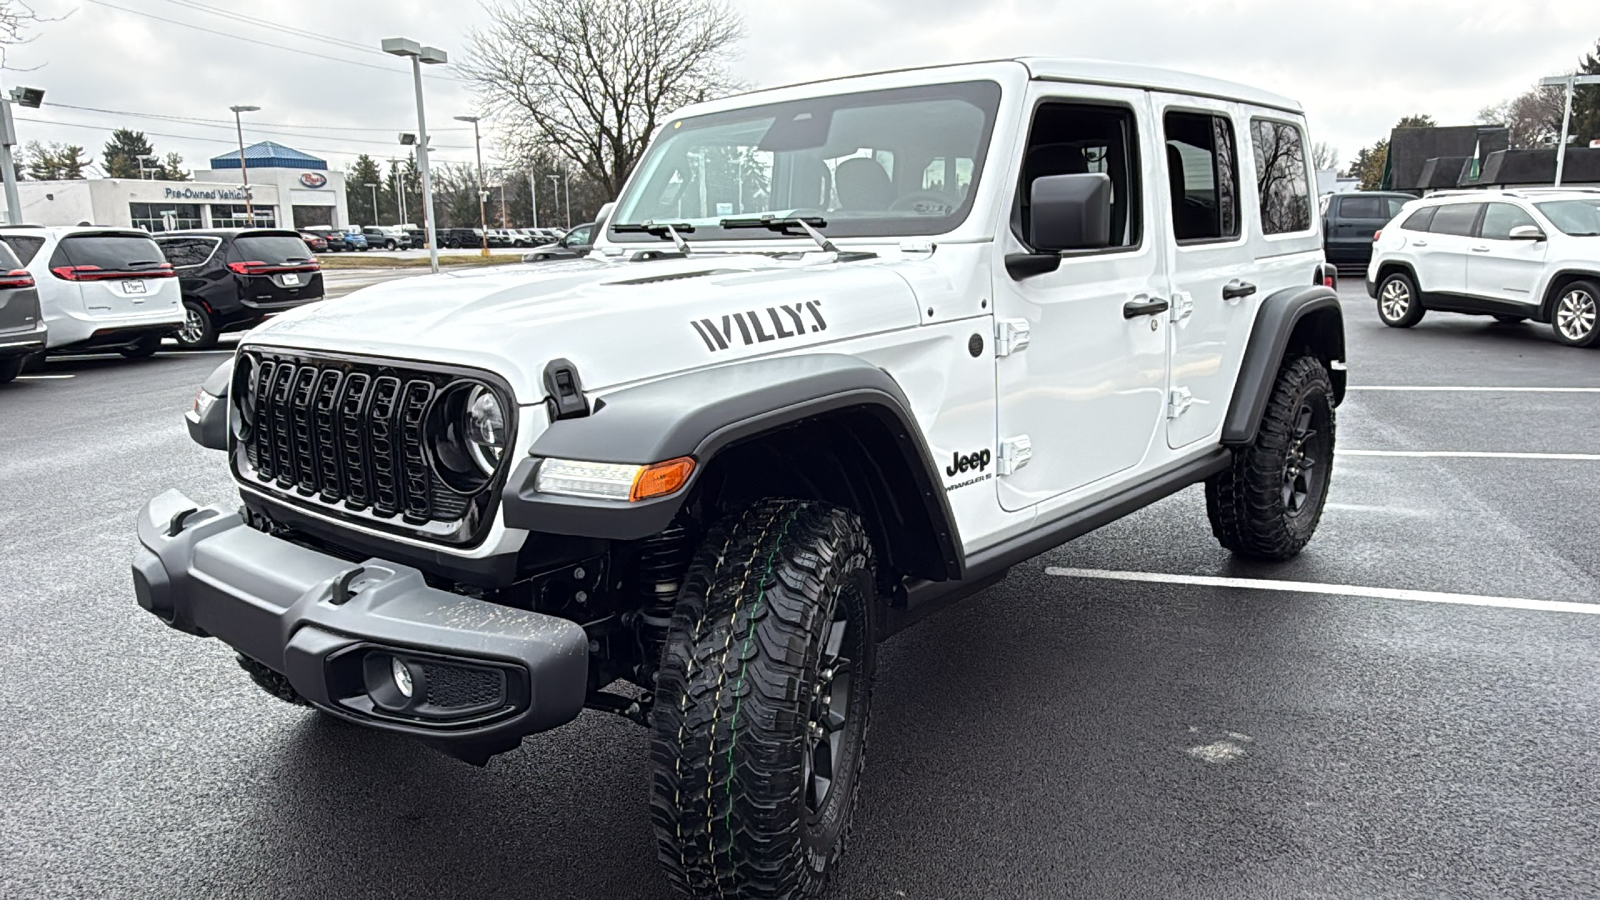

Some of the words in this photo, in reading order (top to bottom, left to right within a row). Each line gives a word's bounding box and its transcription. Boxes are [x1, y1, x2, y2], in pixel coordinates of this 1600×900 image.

[165, 187, 216, 200] Pre-Owned
[690, 299, 827, 352] WILLYS
[946, 448, 991, 477] Jeep
[945, 475, 985, 492] WRANGLER
